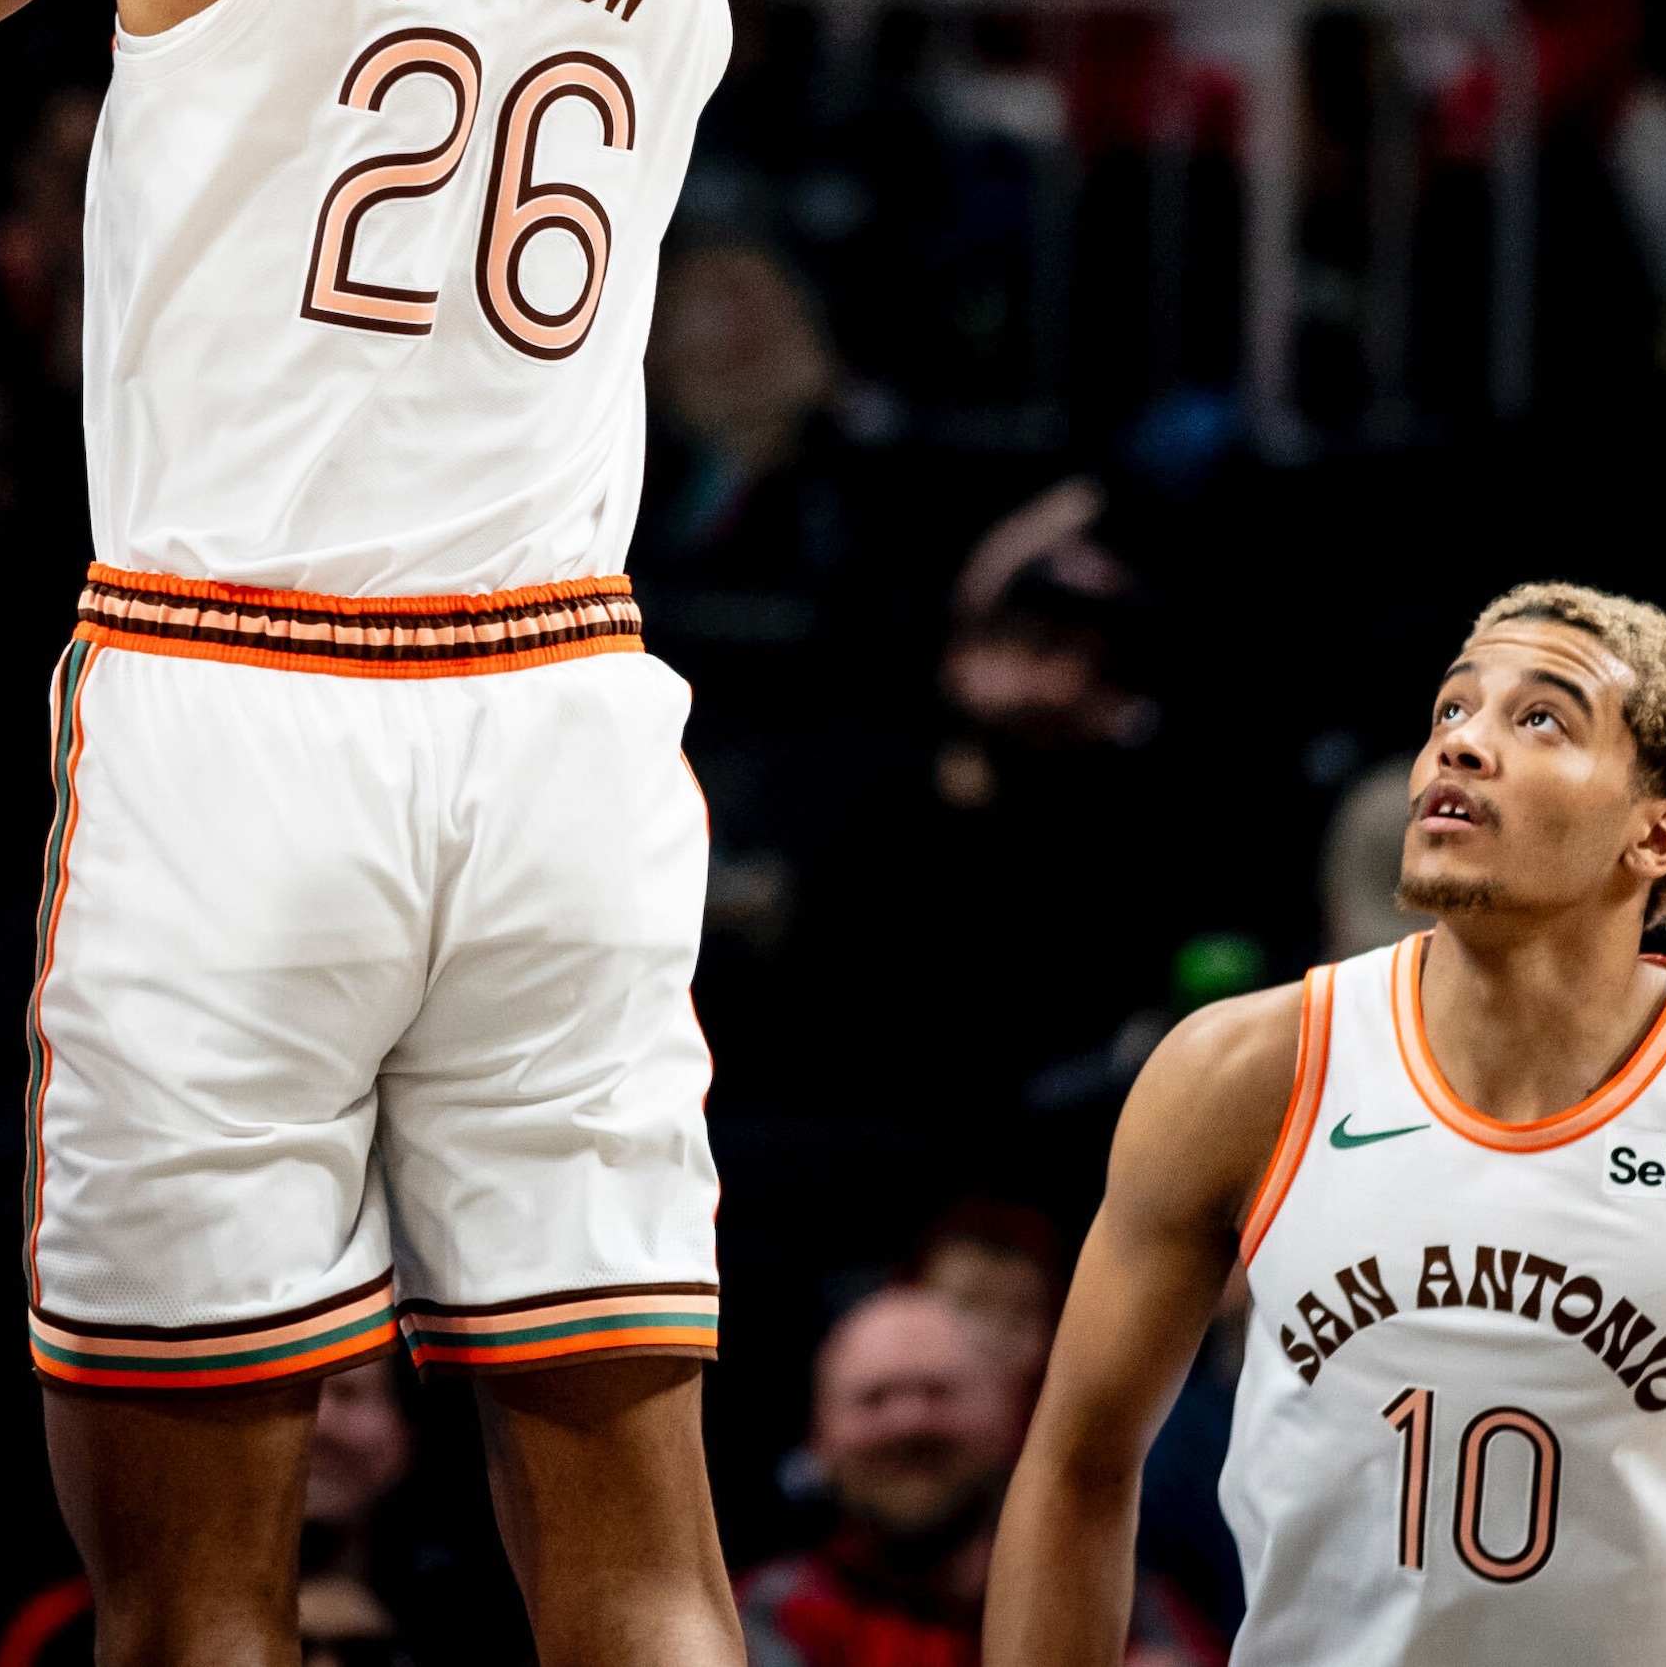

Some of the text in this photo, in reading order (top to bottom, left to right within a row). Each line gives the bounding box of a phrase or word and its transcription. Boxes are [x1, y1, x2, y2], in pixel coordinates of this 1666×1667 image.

[299, 26, 635, 361] 26
[1279, 1256, 1399, 1387] SAN
[1380, 1387, 1562, 1584] 10
